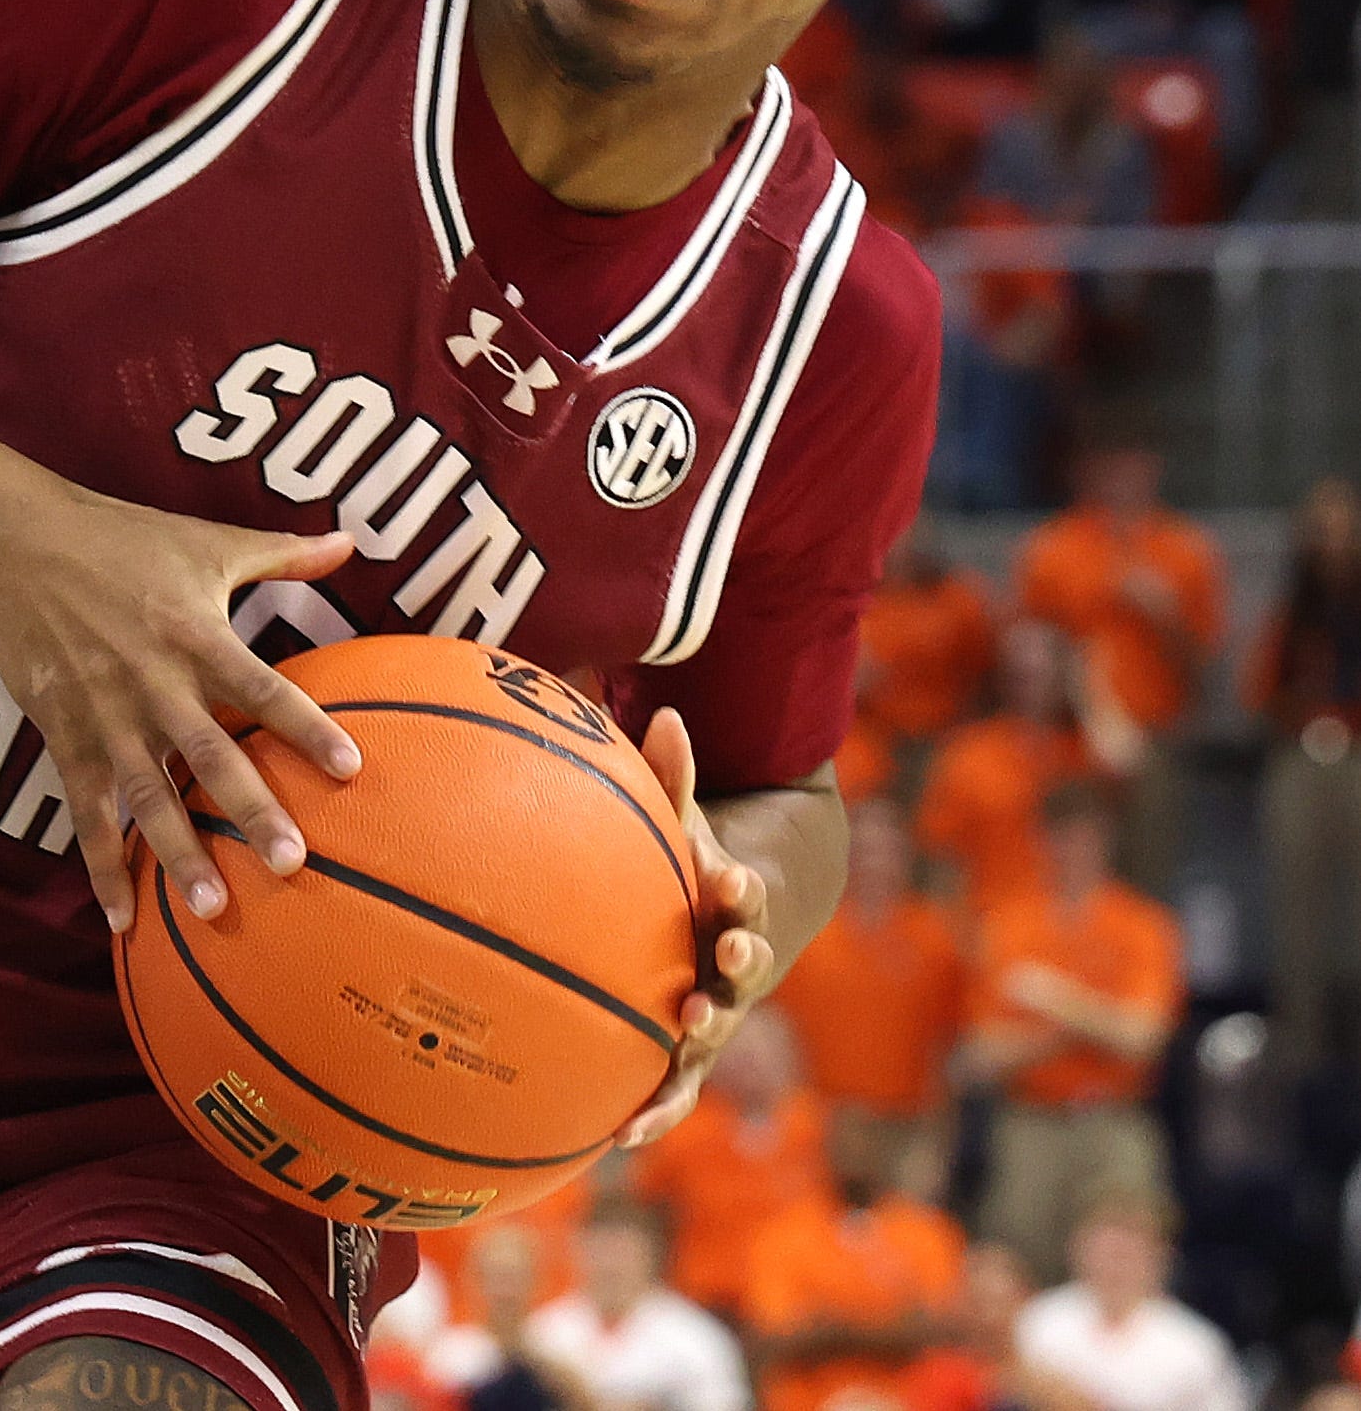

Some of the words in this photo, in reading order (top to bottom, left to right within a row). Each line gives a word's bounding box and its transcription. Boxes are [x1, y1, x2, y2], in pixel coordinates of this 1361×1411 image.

[174, 343, 547, 648] SOUTH
[593, 394, 689, 503] SEC
[192, 1077, 498, 1229] ELITE
